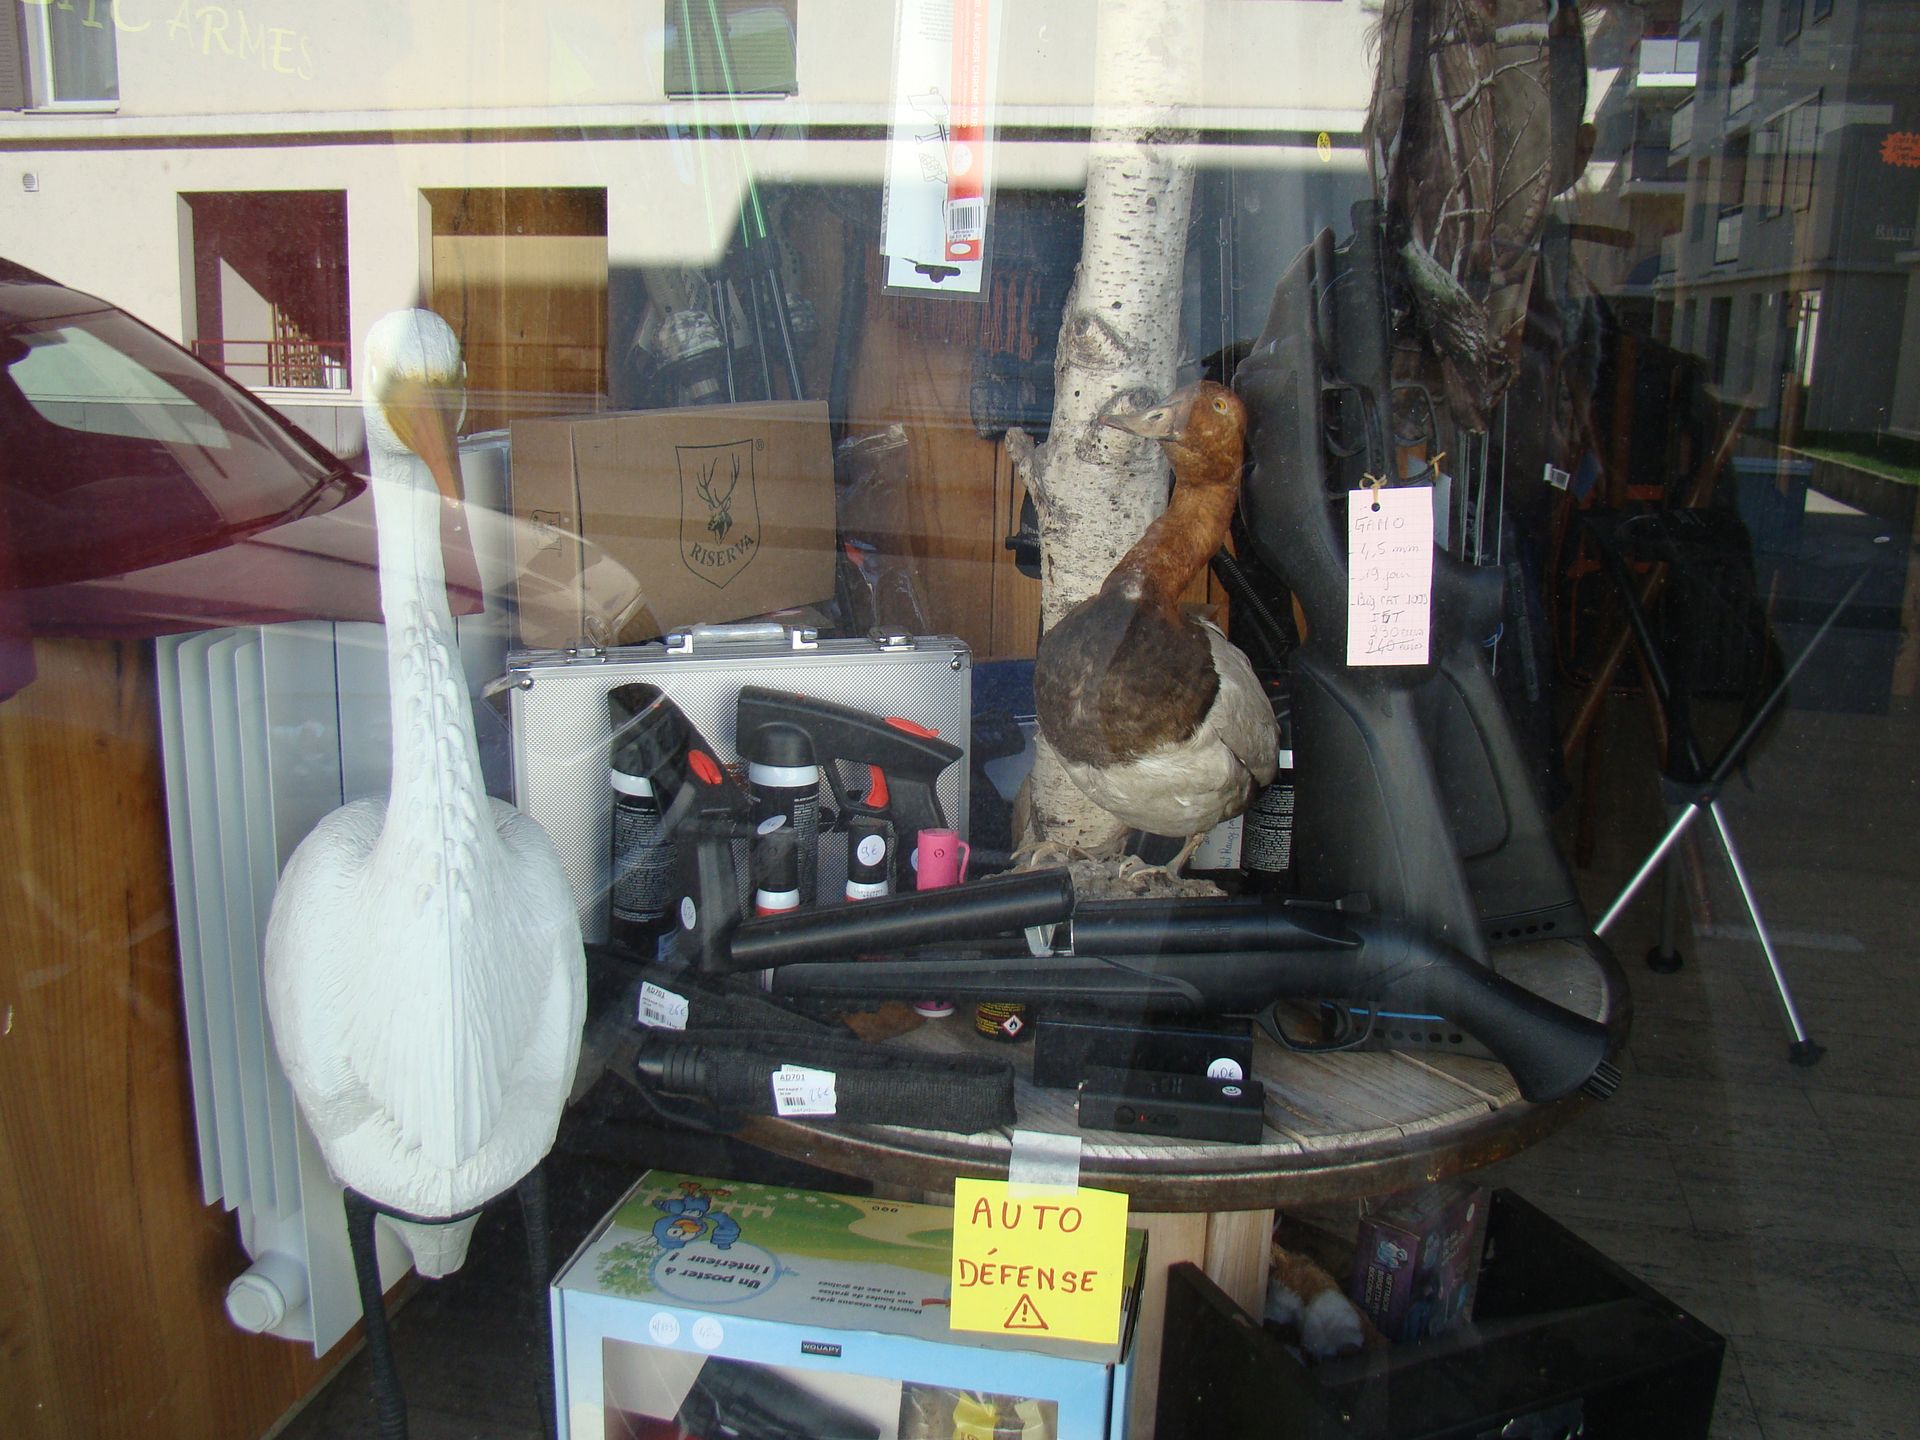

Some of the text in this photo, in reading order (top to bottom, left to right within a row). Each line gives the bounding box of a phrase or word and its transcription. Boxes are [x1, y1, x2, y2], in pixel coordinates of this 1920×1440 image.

[168, 0, 314, 81] ARMES
[689, 533, 755, 568] RISERVA
[779, 1073, 806, 1081] AD701
[972, 1197, 1082, 1233] AUTO
[678, 1269, 736, 1285] poster
[737, 1278, 763, 1290] Un
[958, 1248, 1098, 1293] DÉFENSE
